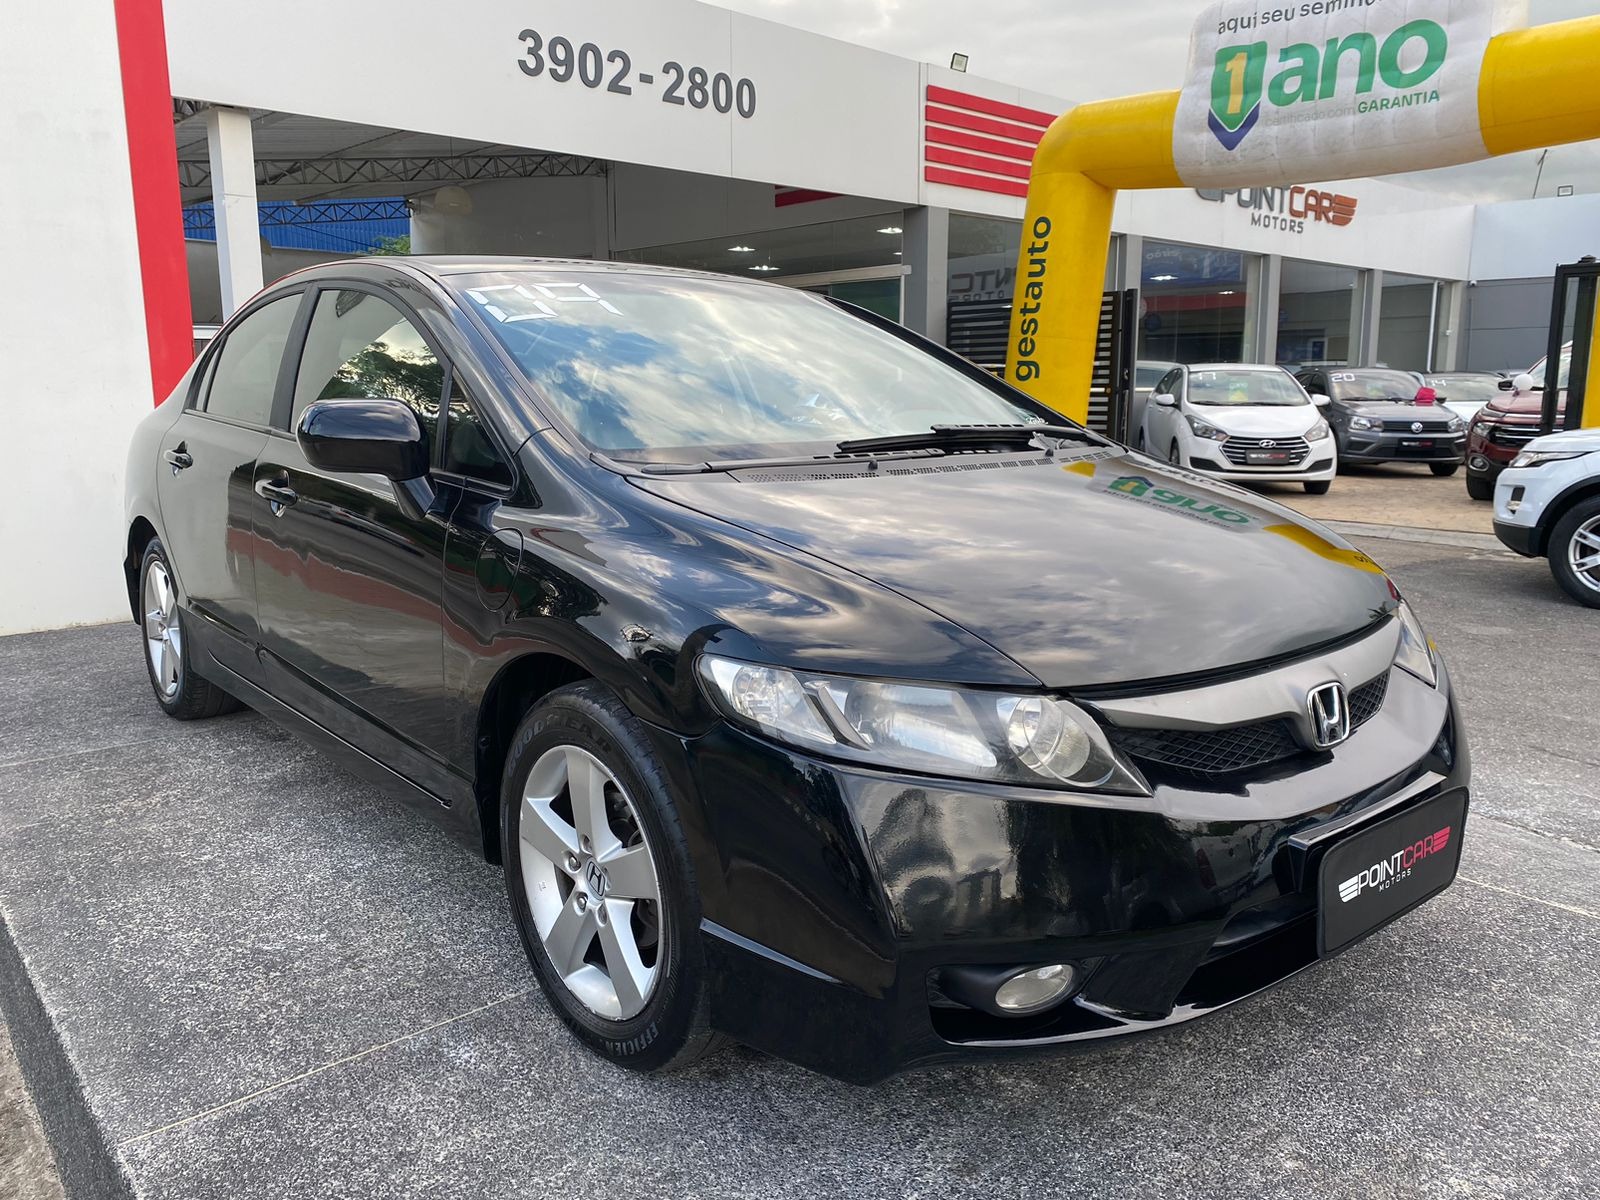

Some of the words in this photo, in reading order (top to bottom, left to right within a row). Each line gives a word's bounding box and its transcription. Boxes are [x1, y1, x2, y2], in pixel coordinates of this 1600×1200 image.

[1217, 12, 1257, 35] aqui
[1260, 7, 1295, 25] seu
[517, 28, 757, 119] 3902-2800
[1267, 19, 1448, 107] ano
[1357, 89, 1441, 114] GARANTIA
[1250, 213, 1304, 234] MOTORS
[1015, 216, 1052, 382] gestauto
[1331, 373, 1355, 383] 20
[1378, 868, 1412, 892] MOTORS
